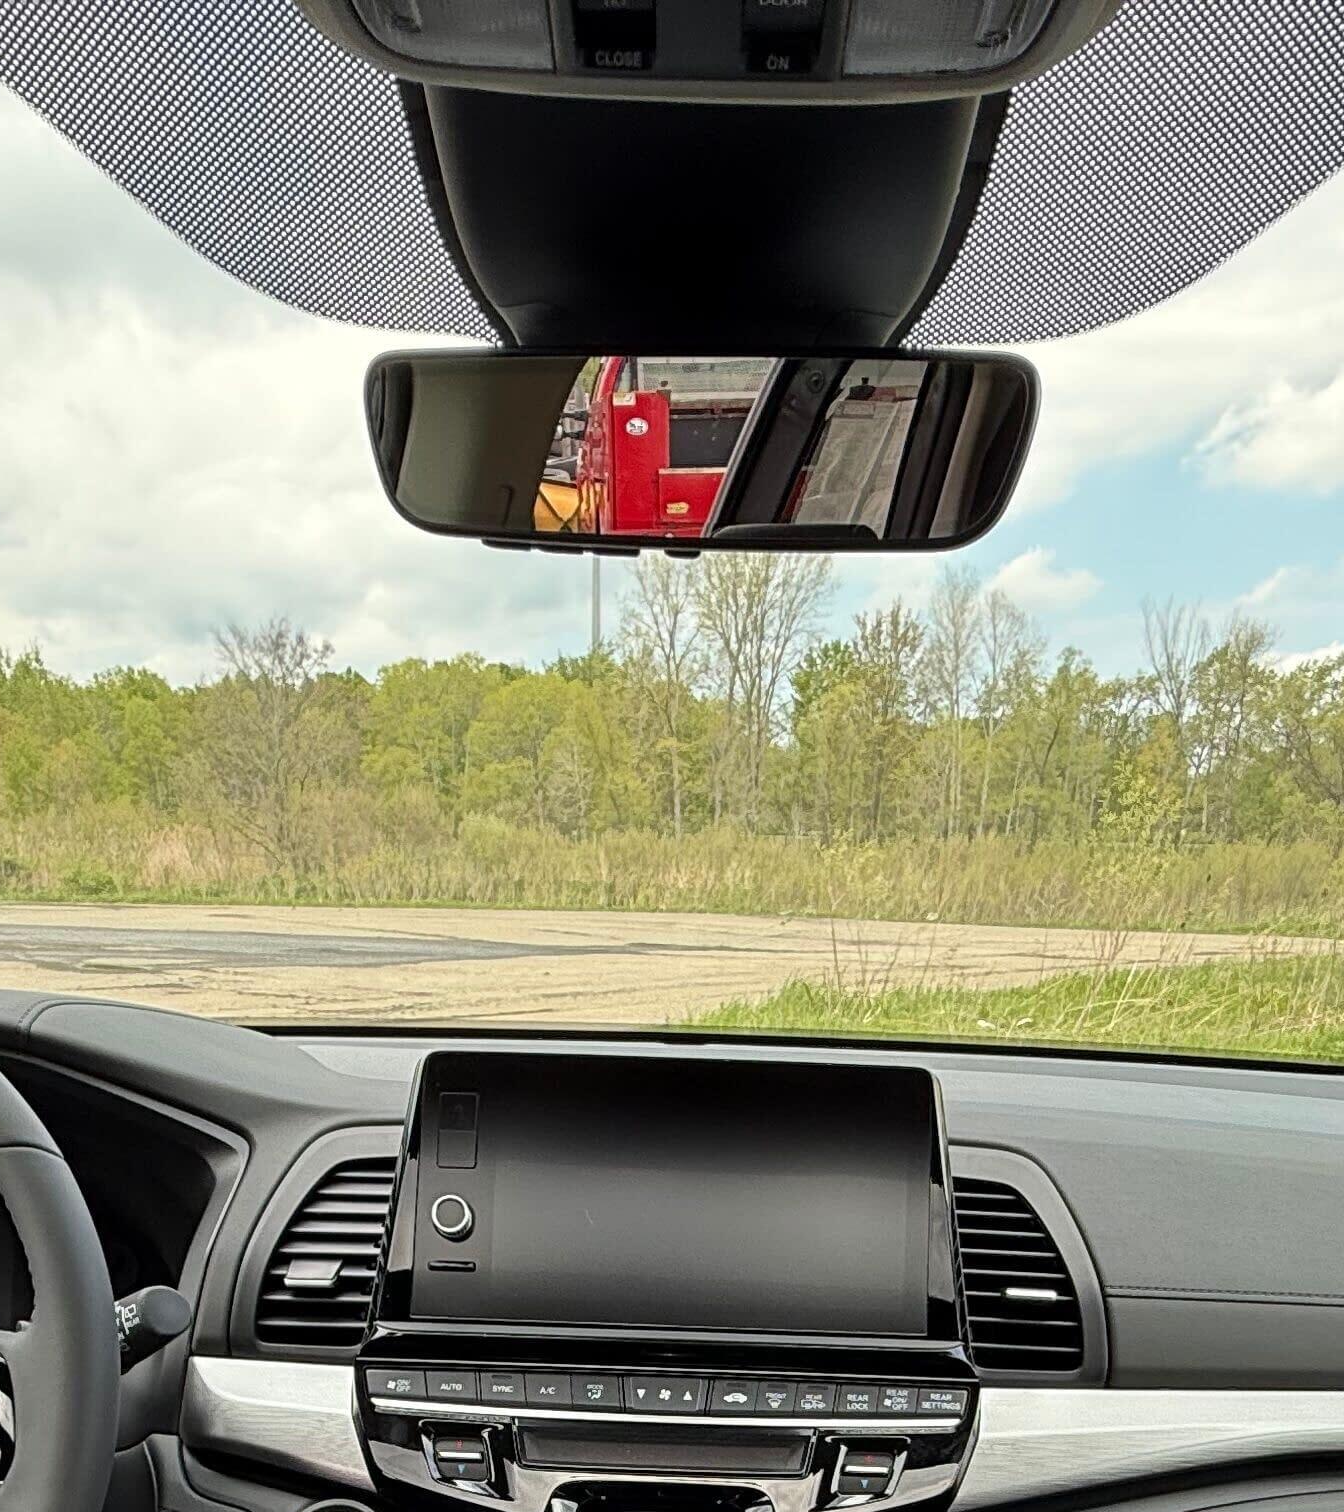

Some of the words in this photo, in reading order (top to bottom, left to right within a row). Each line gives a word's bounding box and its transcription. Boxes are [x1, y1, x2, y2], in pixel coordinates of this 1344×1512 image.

[595, 51, 641, 68] CLOSE
[766, 54, 790, 70] ON
[440, 1383, 462, 1391] AUTO
[492, 1385, 514, 1393] SYNC
[539, 1386, 556, 1394] A/C
[885, 1389, 908, 1397] REAR
[930, 1393, 952, 1401] REAR
[847, 1393, 869, 1402] REAR
[846, 1402, 869, 1410] LOCK
[921, 1401, 961, 1411] SETTINGS
